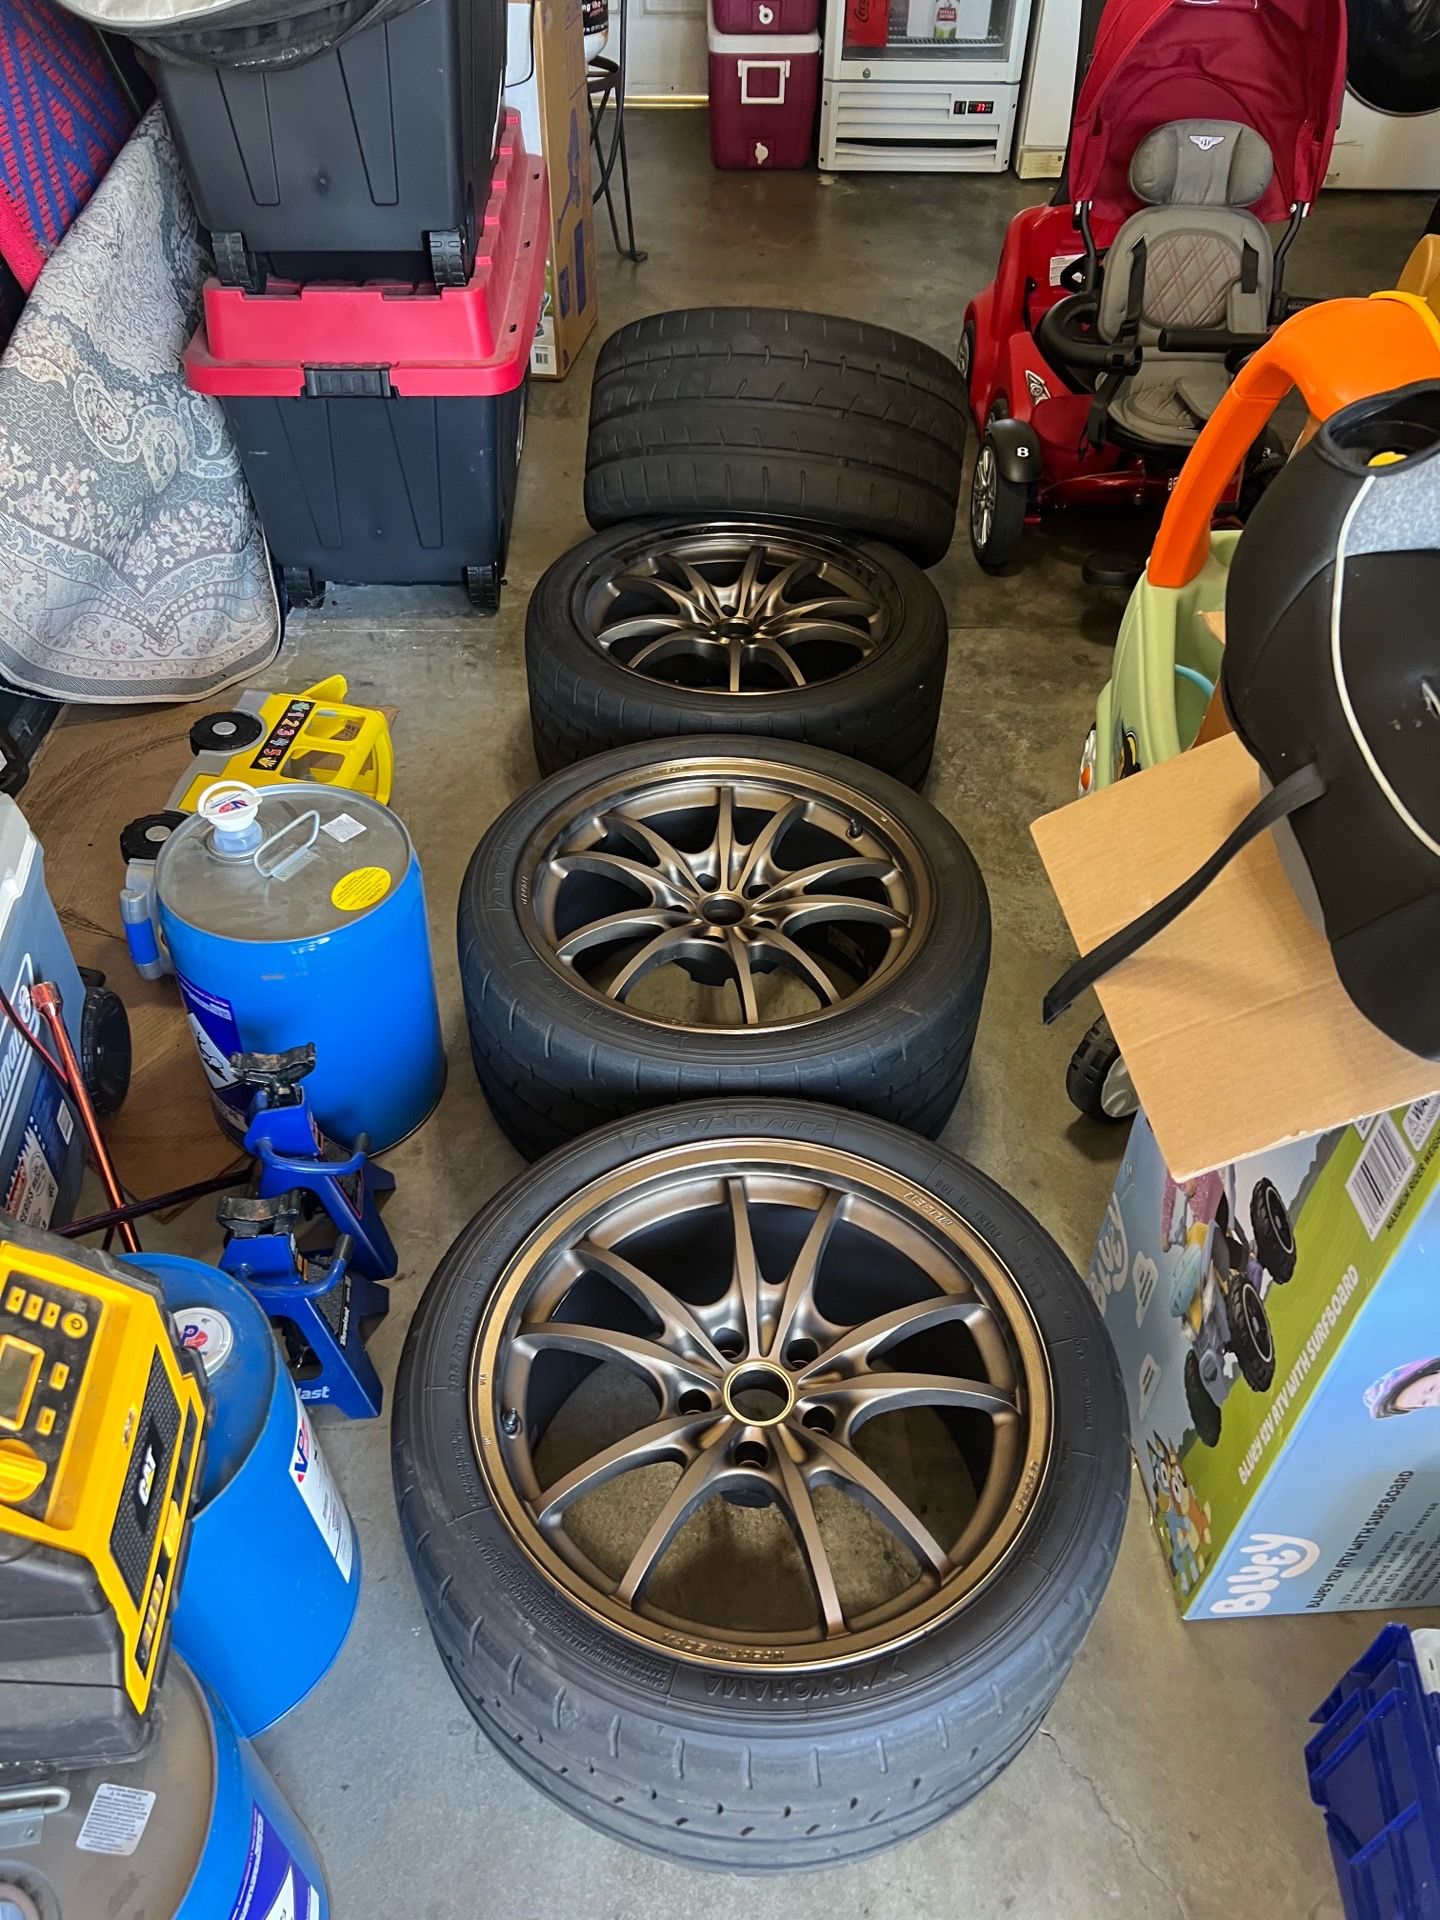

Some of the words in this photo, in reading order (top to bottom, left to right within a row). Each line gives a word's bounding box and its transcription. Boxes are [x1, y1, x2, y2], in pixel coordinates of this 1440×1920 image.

[276, 728, 295, 736] 3
[281, 718, 300, 727] 2
[1272, 1391, 1290, 1426] ATV
[1285, 1352, 1311, 1398] WITH
[139, 1444, 156, 1505] CAT
[1345, 1526, 1377, 1550] WITH
[1210, 1533, 1320, 1614] BLUEY
[1333, 1552, 1358, 1568] ATV
[698, 1664, 870, 1705] YOKOHAMA
